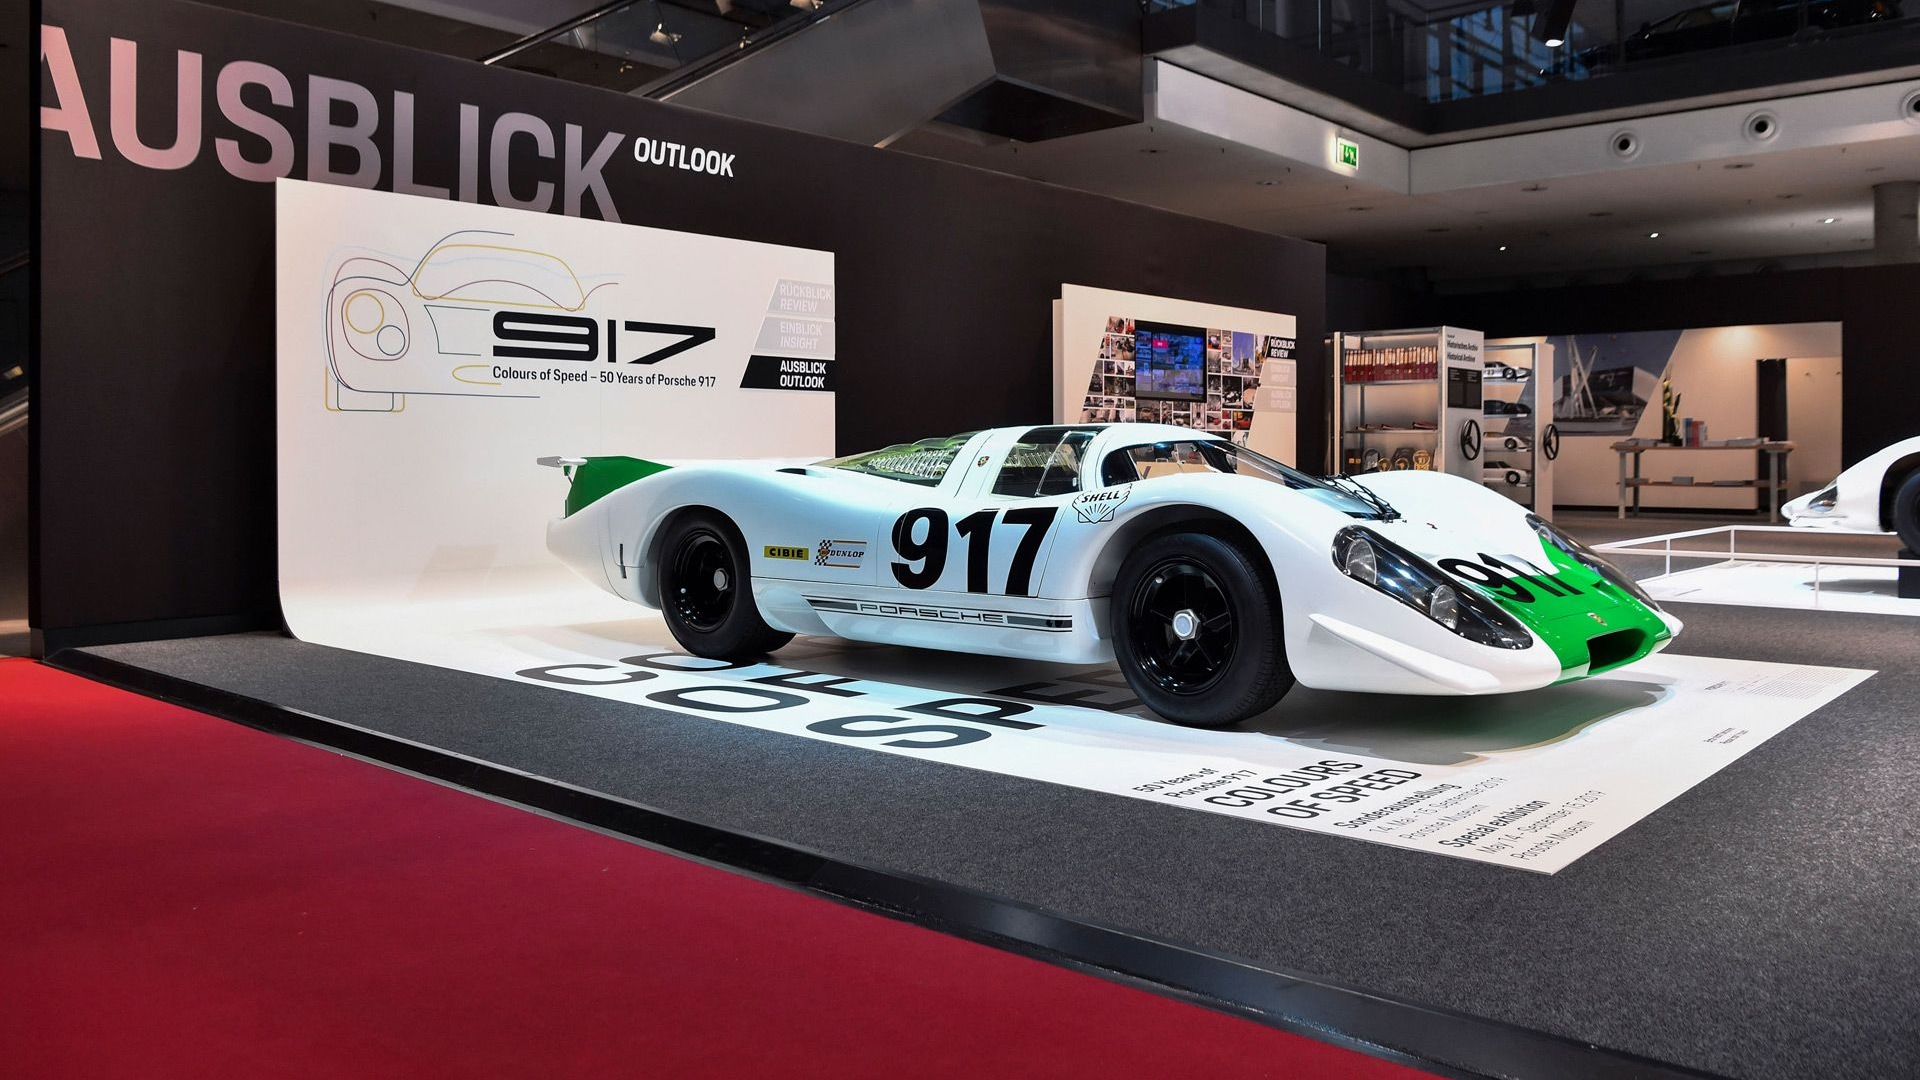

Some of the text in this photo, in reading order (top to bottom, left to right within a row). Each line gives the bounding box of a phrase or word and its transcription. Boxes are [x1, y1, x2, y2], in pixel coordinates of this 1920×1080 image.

[41, 24, 626, 223] AUSBLICK
[633, 137, 736, 178] OUTLOOK
[780, 282, 832, 300] RÜCKBLICK
[780, 300, 818, 312] REVIEW
[493, 311, 716, 365] 917
[780, 321, 822, 336] EINBLICK
[780, 337, 818, 349] INSIGHT
[1270, 349, 1289, 358] REVIEW
[780, 360, 826, 374] AUSBLICK
[493, 366, 536, 380] Colours
[540, 369, 551, 381] of
[553, 368, 588, 384] Speed
[600, 371, 614, 383] 50
[616, 372, 643, 385] Years
[645, 373, 657, 385] of
[658, 374, 697, 387] Porsche
[699, 376, 716, 388] 917
[780, 375, 824, 388] OUTLOOK
[1081, 491, 1120, 503] SHELL
[769, 548, 804, 558] CIBIE
[829, 550, 865, 558] DUNLOP
[891, 507, 1059, 597] 917
[860, 604, 1003, 623] PORSCHE
[1132, 783, 1165, 793] 50
[1157, 774, 1205, 785] Years
[1163, 769, 1258, 798] Porsche 917
[1204, 760, 1363, 807] COLOURS
[1310, 768, 1422, 803] SPEED
[1266, 800, 1332, 819] OF
[1333, 783, 1462, 829] Sonderausstellung
[1437, 801, 1551, 848] Special exhibition
[1517, 809, 1573, 833] September
[1510, 821, 1593, 861] Porsche Museum
